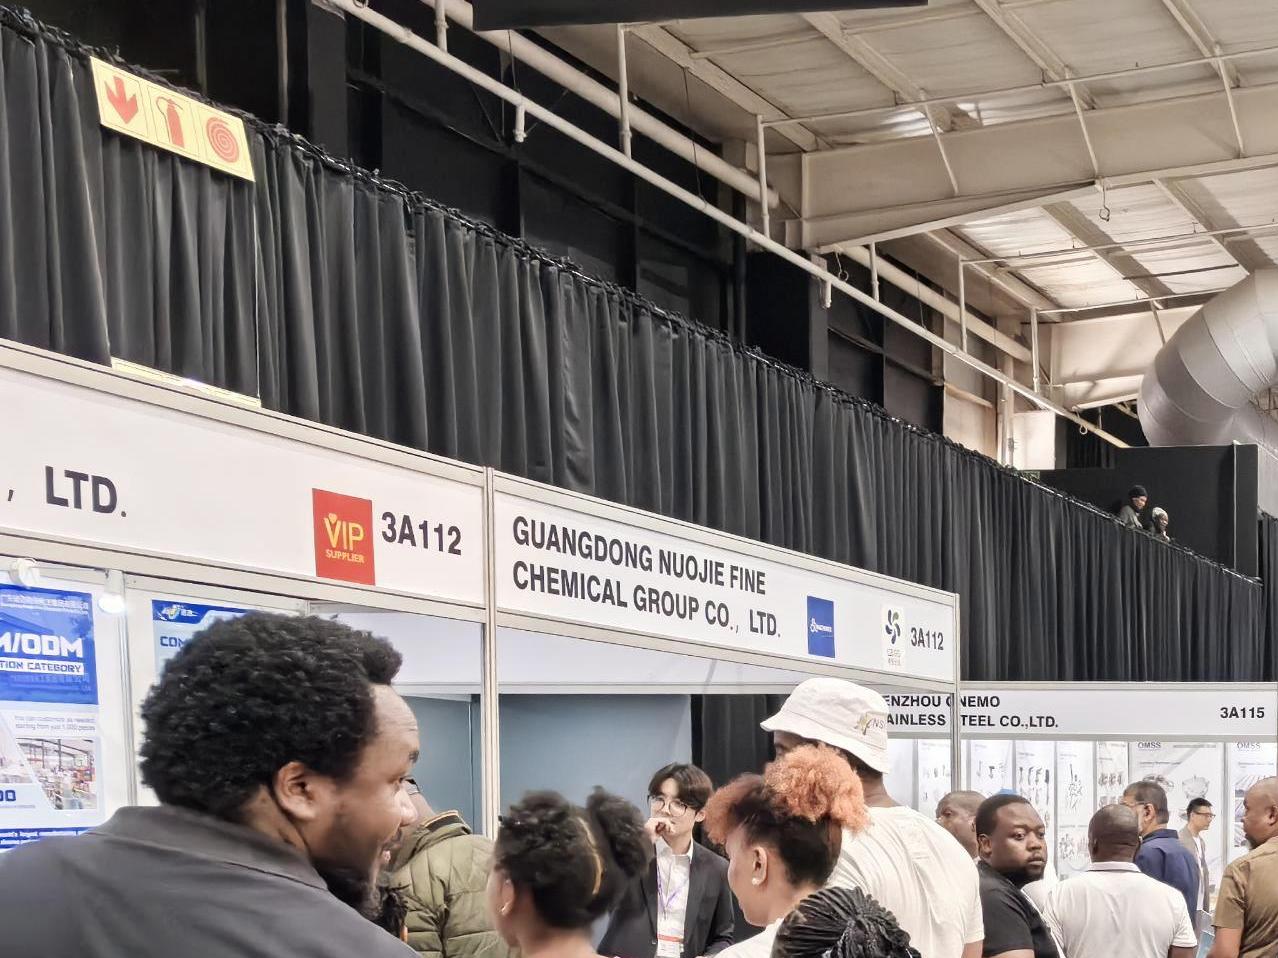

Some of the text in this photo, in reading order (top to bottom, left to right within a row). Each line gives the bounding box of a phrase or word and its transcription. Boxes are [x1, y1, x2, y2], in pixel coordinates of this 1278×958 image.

[45, 465, 127, 518] LTD.
[323, 516, 365, 551] VIP
[381, 511, 462, 556] 3A112
[325, 548, 365, 564] SUPPLIER
[512, 515, 767, 596] GUANGDONG NUOJIE FINE
[512, 560, 628, 608] CHEMICAL
[633, 584, 700, 621] GROUP
[749, 608, 781, 638] LTD.
[910, 626, 945, 651] 3A112
[26, 662, 81, 674] CATEGORY
[882, 694, 942, 708] ENZHOU
[1219, 706, 1265, 719] 3A115
[887, 713, 947, 726] AINLESS
[960, 714, 996, 727] TEEL
[999, 715, 1059, 730] CO.,LTD.
